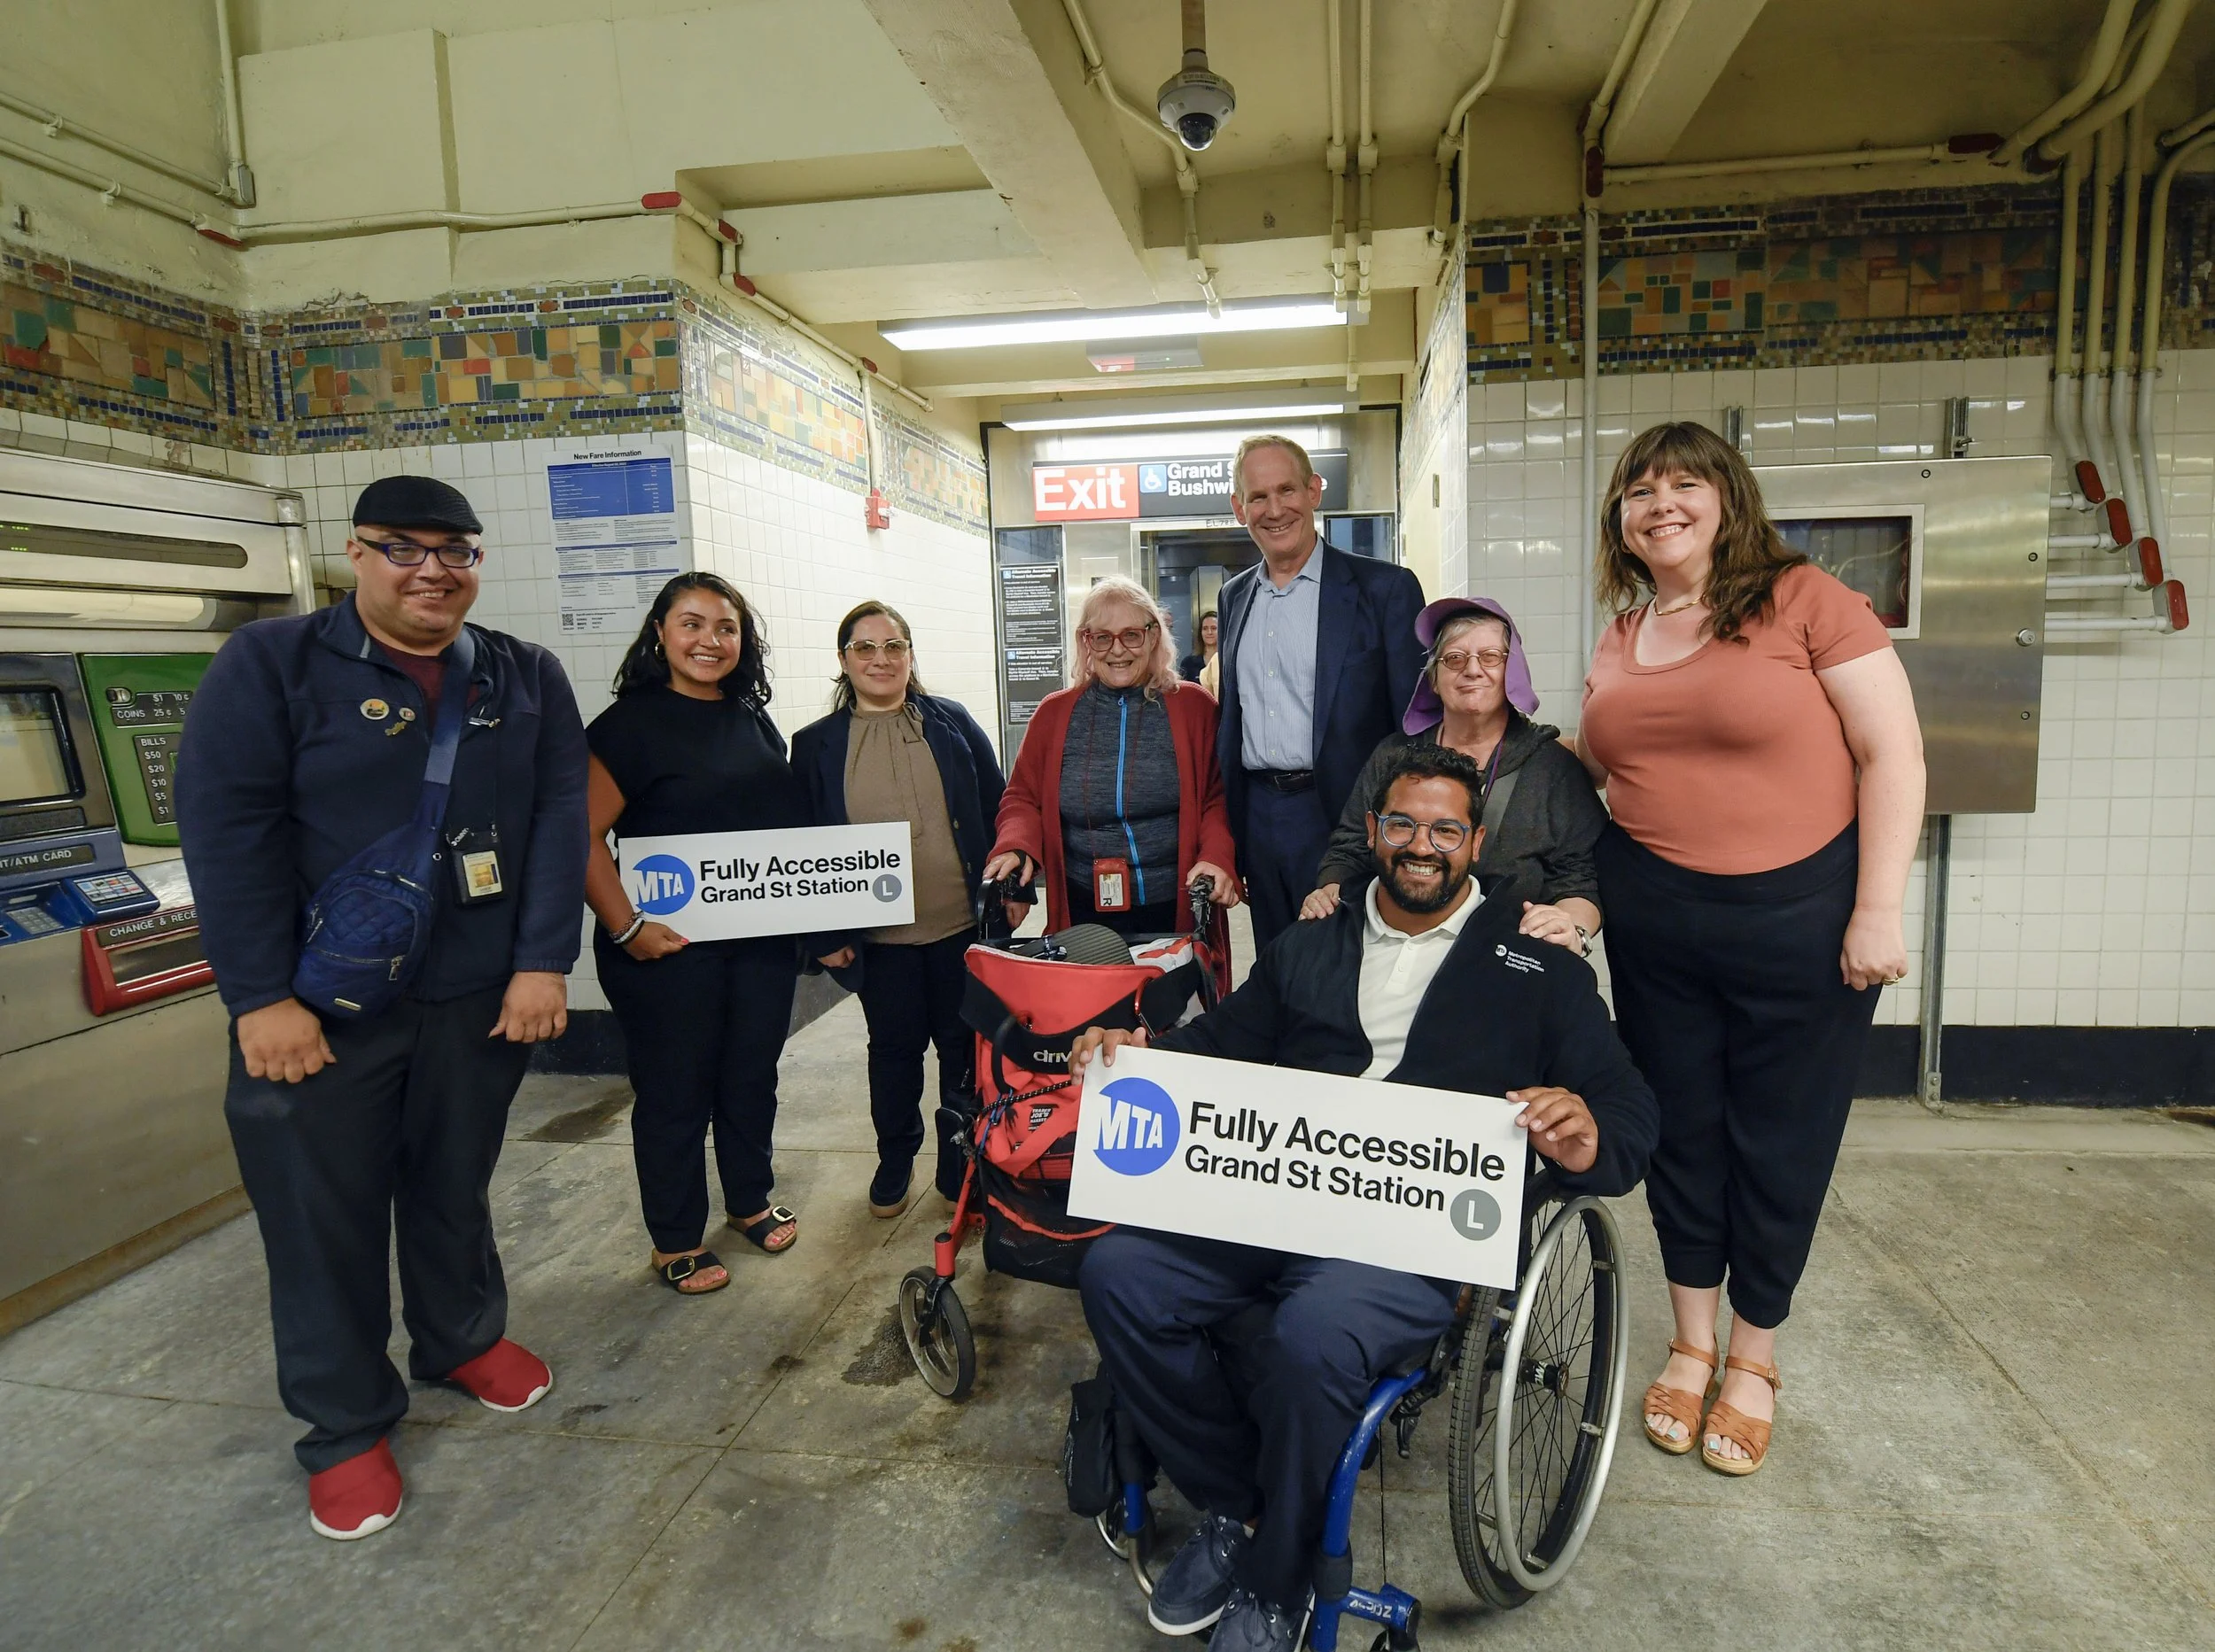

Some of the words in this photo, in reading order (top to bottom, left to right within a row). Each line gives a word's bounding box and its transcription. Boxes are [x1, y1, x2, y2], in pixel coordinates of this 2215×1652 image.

[573, 452, 588, 461] New
[589, 451, 604, 460] Fare
[605, 449, 642, 458] Information
[1167, 461, 1223, 480] Grand
[1034, 467, 1126, 512] Exit
[1168, 478, 1235, 497] Bushwi
[117, 710, 146, 719] COINS
[140, 737, 167, 747] BILLS
[144, 750, 161, 760] $50
[148, 764, 165, 774] $20
[152, 779, 167, 787] $10
[155, 792, 167, 802] $5
[158, 806, 169, 815] $1
[43, 849, 72, 862] CARD
[699, 857, 760, 882] Fully
[766, 849, 901, 877] Accessible
[634, 869, 686, 904] MTA
[700, 883, 766, 904] Grand
[770, 880, 793, 899] St
[797, 877, 869, 896] Station
[882, 880, 894, 896] L
[109, 919, 155, 938] CHANGE
[159, 917, 167, 926] &
[170, 910, 198, 923] RECE
[1506, 955, 1545, 973] Transportation
[1508, 950, 1542, 966] Metropolitan
[1504, 960, 1530, 973] Authority
[1032, 1049, 1073, 1064] driv
[1095, 1094, 1164, 1151] MTA
[1188, 1101, 1278, 1152] Fully
[1285, 1117, 1505, 1182] Accessible
[1185, 1144, 1280, 1185] Grand
[1286, 1160, 1320, 1191] St
[1328, 1167, 1445, 1212] Station
[1465, 1200, 1486, 1230] L
